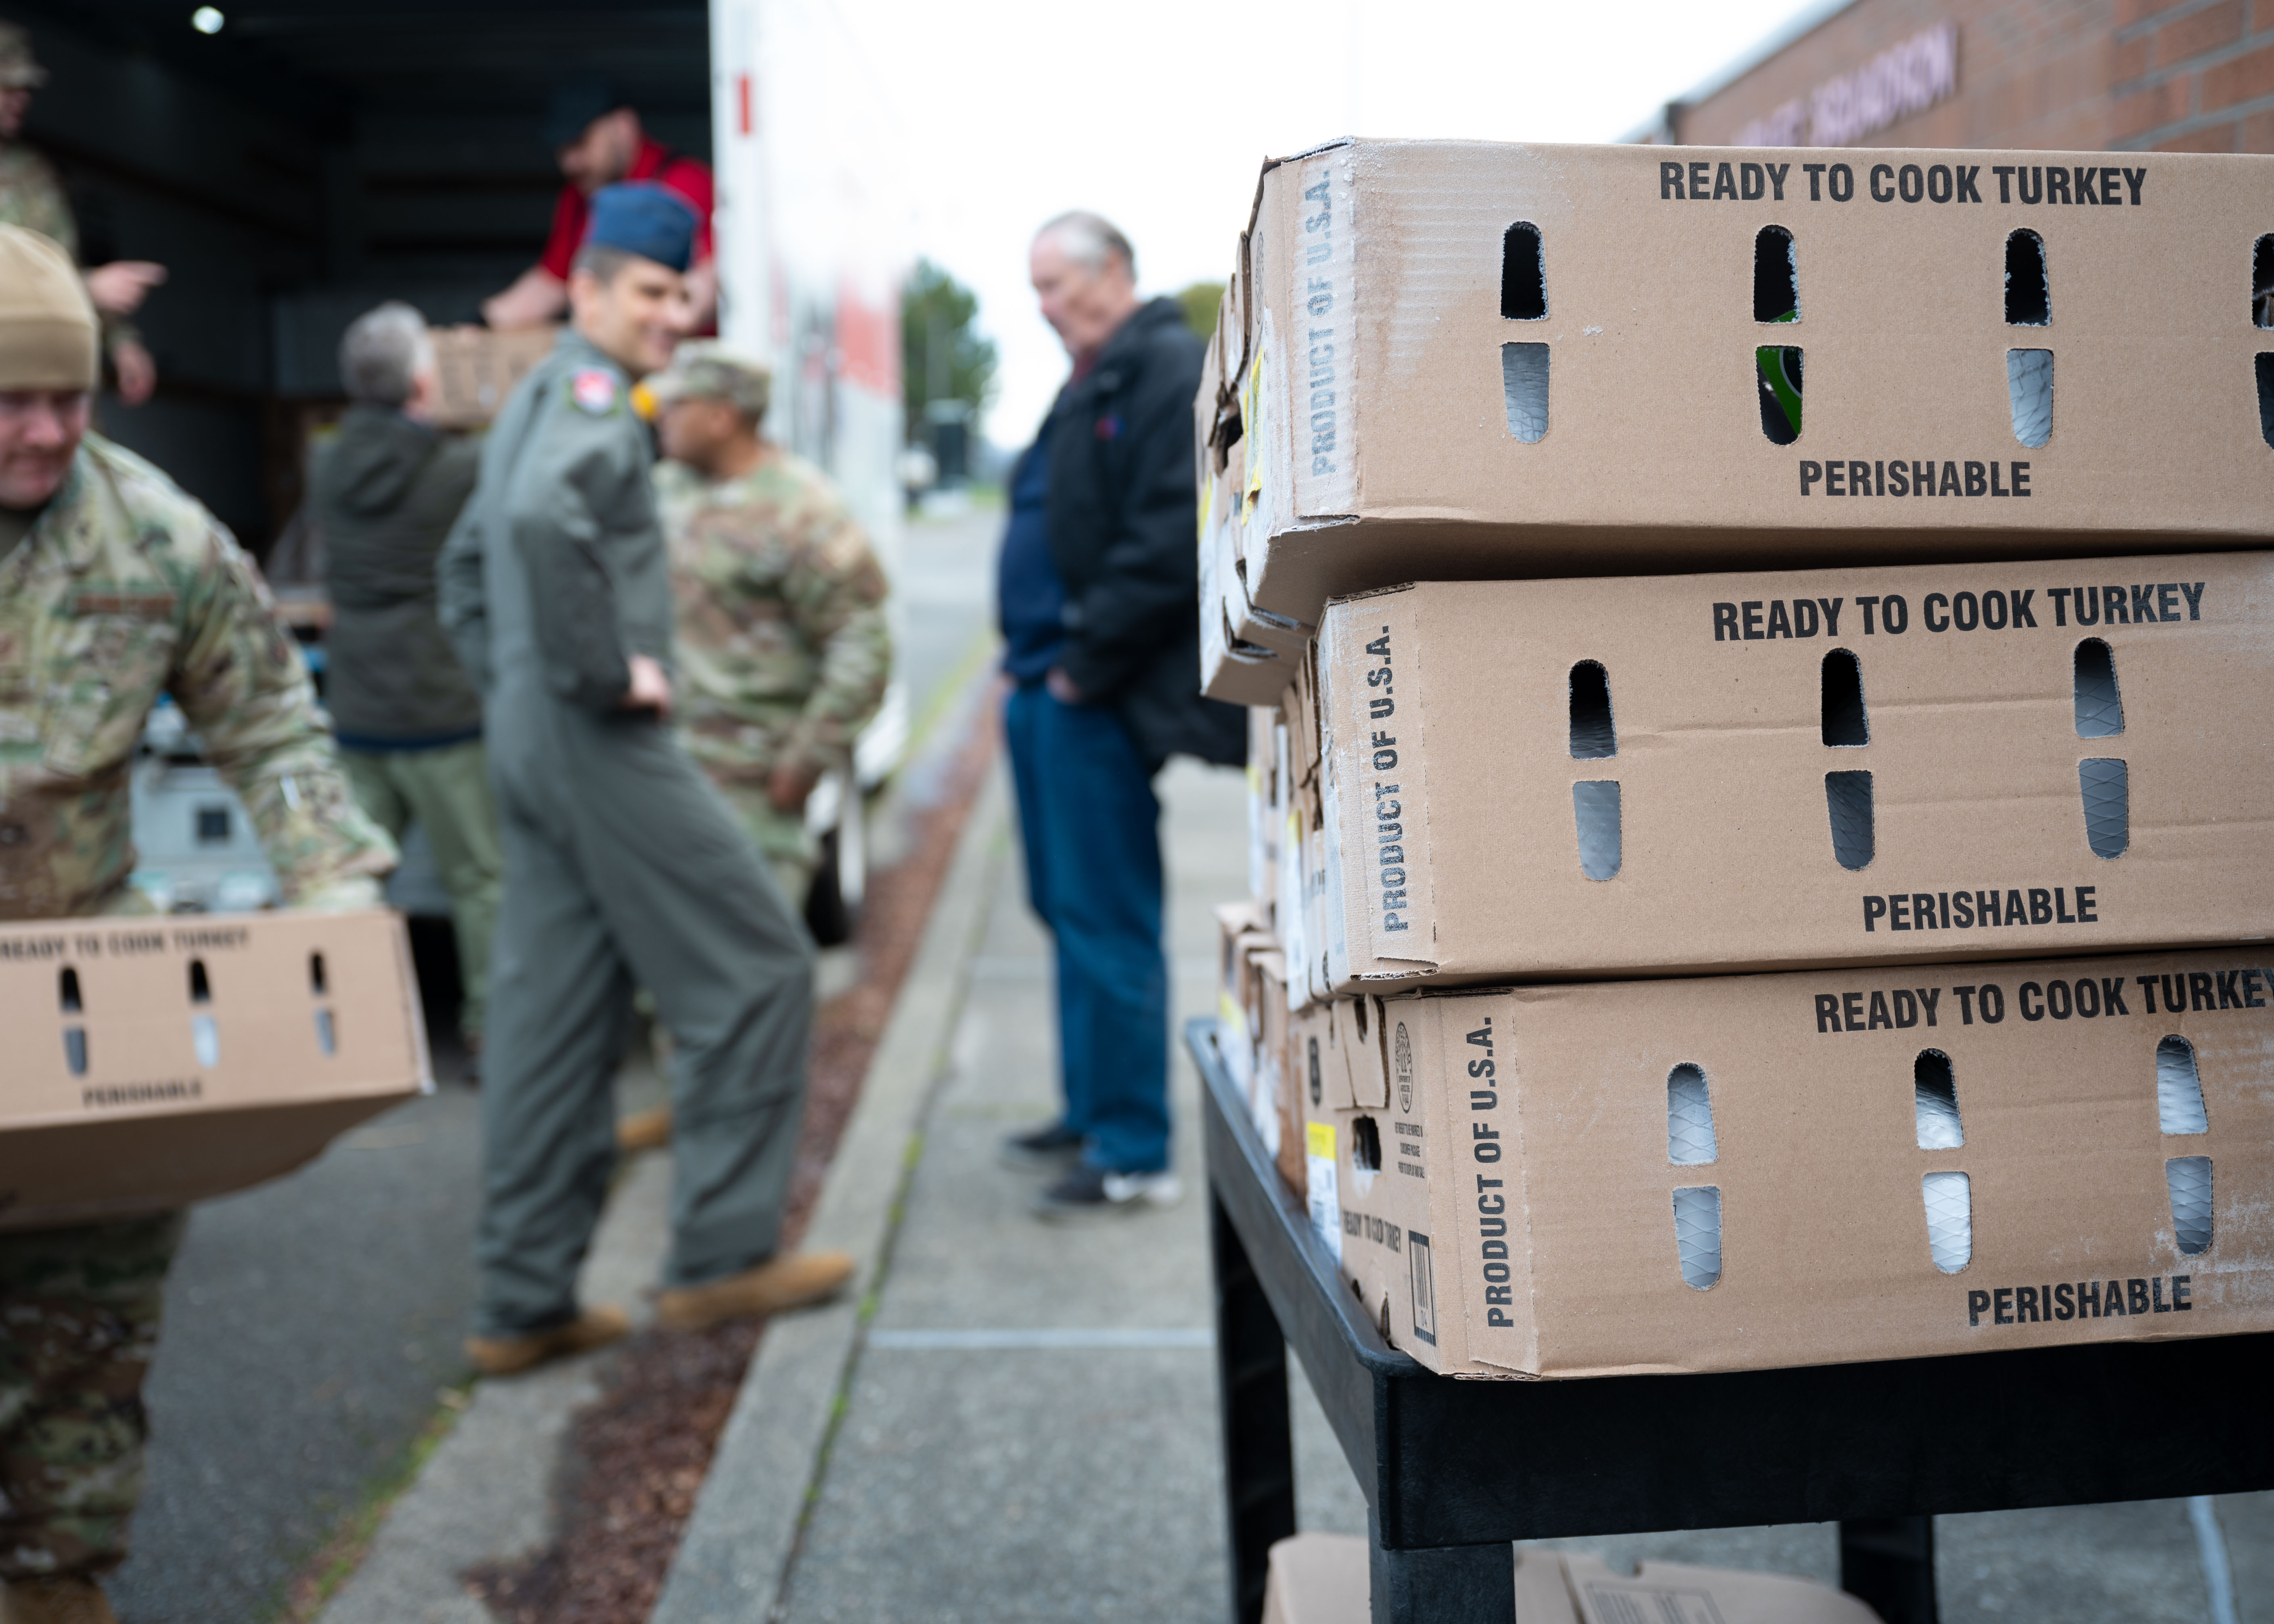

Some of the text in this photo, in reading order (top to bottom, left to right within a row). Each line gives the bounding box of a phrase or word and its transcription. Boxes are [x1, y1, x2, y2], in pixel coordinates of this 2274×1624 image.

[1660, 162, 2147, 205] READY TO COOK TURKEY
[1305, 170, 1337, 477] PRODUCT OF U.S.A.
[1800, 460, 2031, 497] PERISHABLE
[1713, 582, 2205, 641] READY TO COOK TURKEY
[1366, 626, 1409, 932] PRODUCT OF U.S.A.
[1863, 886, 2098, 932] PERISHABLE
[1815, 988, 1941, 1033] READY
[1953, 984, 2005, 1025] TO
[2019, 977, 2130, 1021] COOK
[1466, 1017, 1513, 1327] PRODUCT OF U.S.A.
[1968, 1275, 2192, 1326] PERISHABLE
